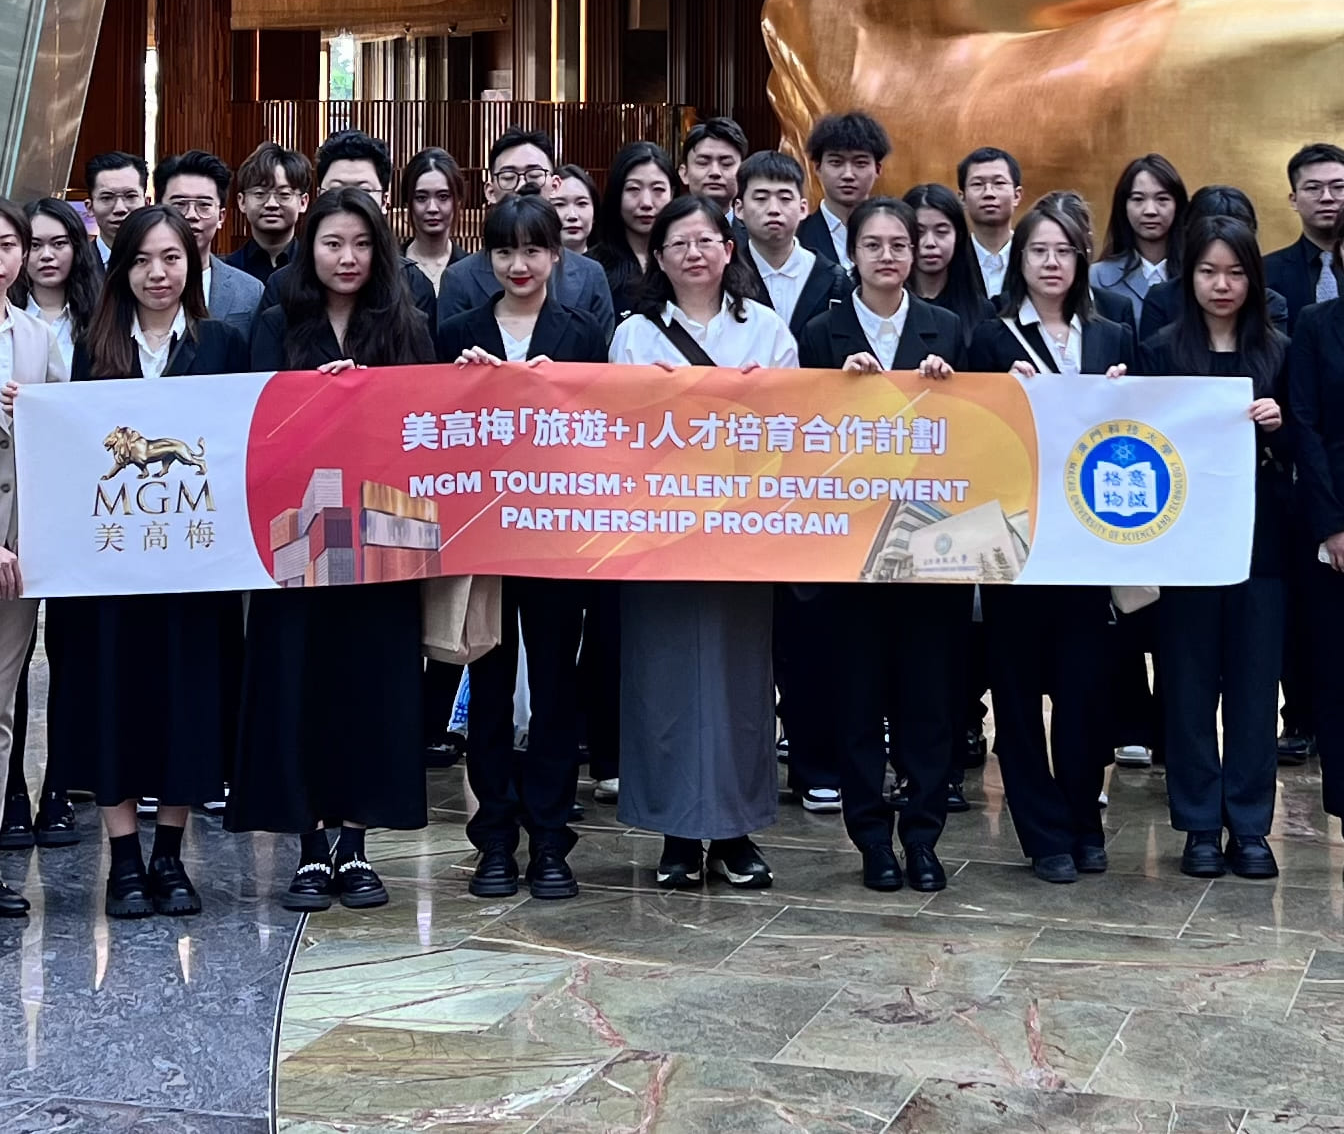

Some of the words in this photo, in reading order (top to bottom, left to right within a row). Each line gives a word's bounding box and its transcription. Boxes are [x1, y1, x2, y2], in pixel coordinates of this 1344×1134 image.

[91, 479, 217, 516] MGM
[408, 470, 482, 498] MGM
[490, 470, 637, 496] TOURISM+
[644, 474, 752, 498] TALENT
[758, 476, 970, 502] DEVELOPMENT
[93, 518, 216, 553] 美高梅
[500, 506, 697, 534] PARTNERSHIP
[703, 511, 849, 535] PROGRAM
[1122, 527, 1157, 542] SCIENCE
[1157, 514, 1172, 531] AND
